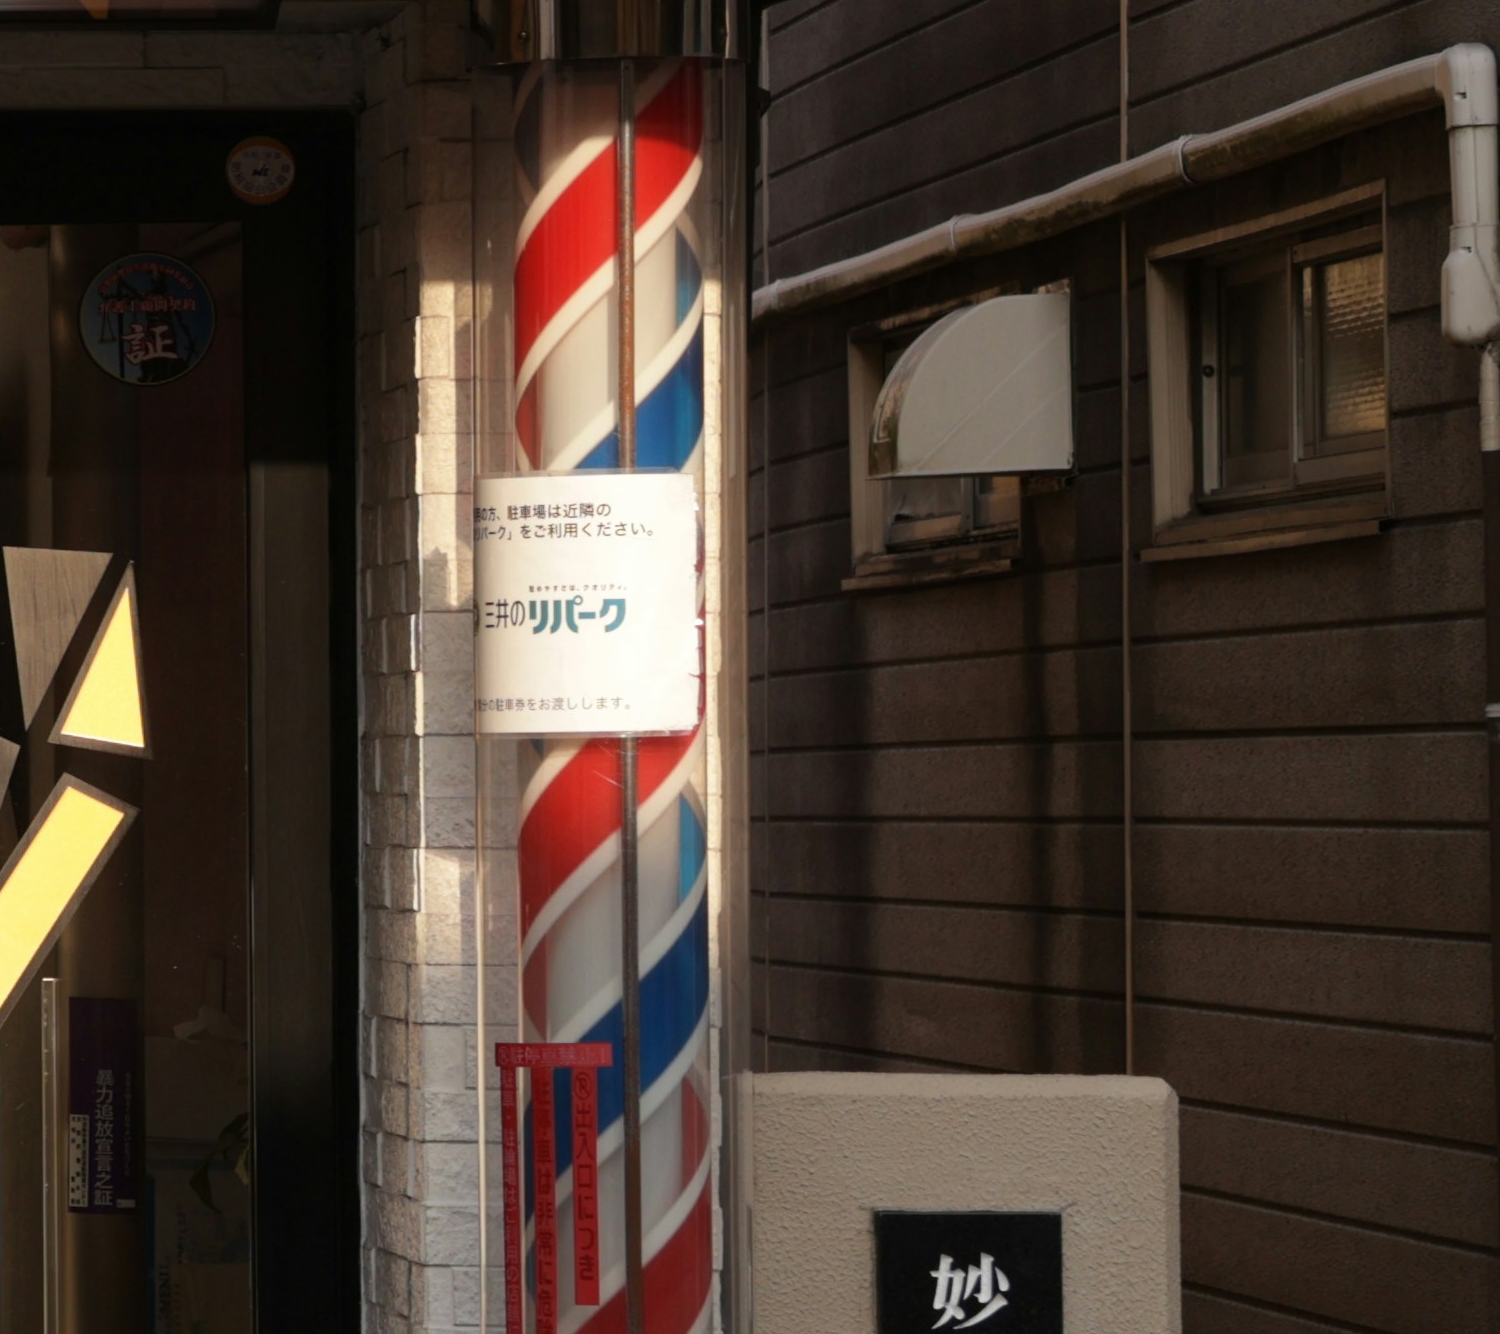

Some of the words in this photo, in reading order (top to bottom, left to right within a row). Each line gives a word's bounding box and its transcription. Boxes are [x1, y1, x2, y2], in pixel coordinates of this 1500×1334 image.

[121, 323, 179, 365] 証
[484, 594, 627, 635] 三井のリパーク
[93, 1068, 116, 1207] 暴力追放宣言之証
